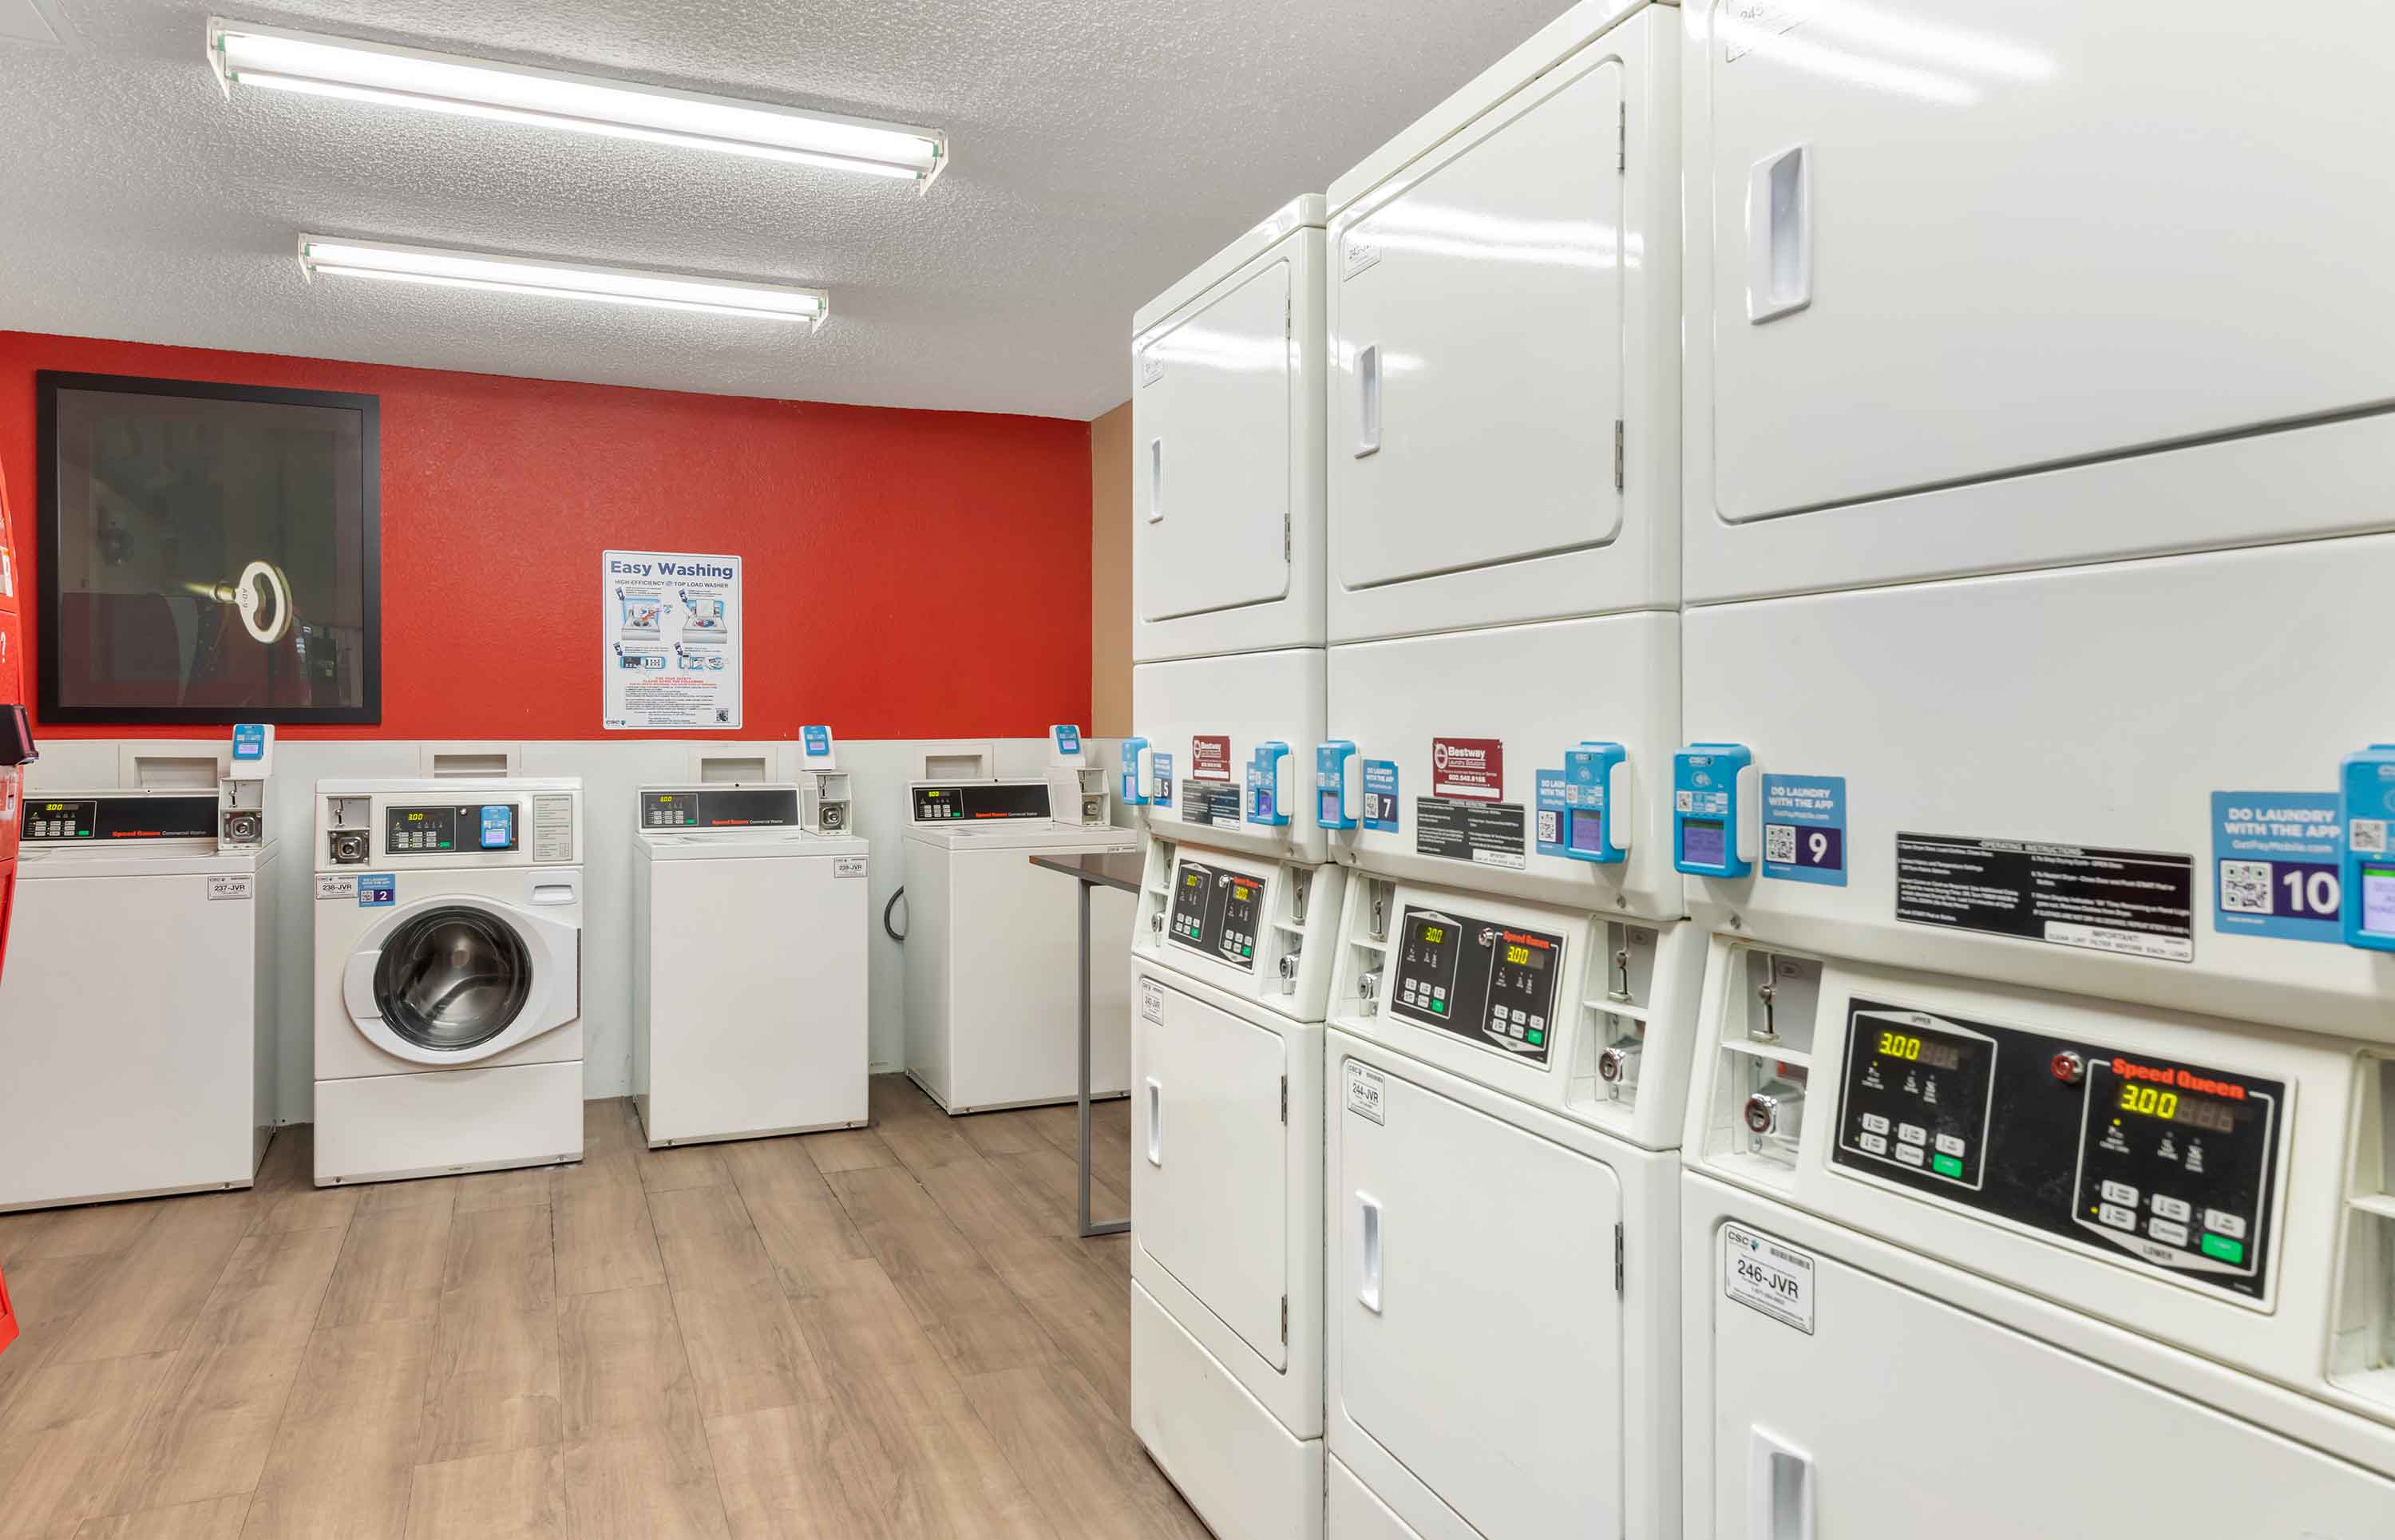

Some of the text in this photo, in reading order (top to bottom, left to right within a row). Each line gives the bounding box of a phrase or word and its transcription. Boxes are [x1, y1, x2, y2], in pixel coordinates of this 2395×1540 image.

[611, 560, 733, 580] Easy Washing
[1448, 746, 1486, 759] Bestway
[1164, 782, 1169, 797] 5
[1771, 786, 1831, 798] DO LAUNDRY
[1384, 798, 1391, 818] 7
[1768, 797, 1834, 810] WITH THE APP
[2228, 808, 2334, 823] DO LAUNDRY
[2225, 822, 2341, 838] WITH THE APP
[1808, 833, 1828, 863] 9
[379, 890, 387, 901] 2
[2283, 870, 2341, 914] 10
[1878, 1033, 1921, 1061] 3.00
[2112, 1058, 2246, 1100] Speed Queen
[1352, 1083, 1380, 1103] 244-JVR
[2120, 1084, 2178, 1120] 3.00
[1728, 1231, 1749, 1245] CSC
[1738, 1259, 1799, 1299] 246-JVR
